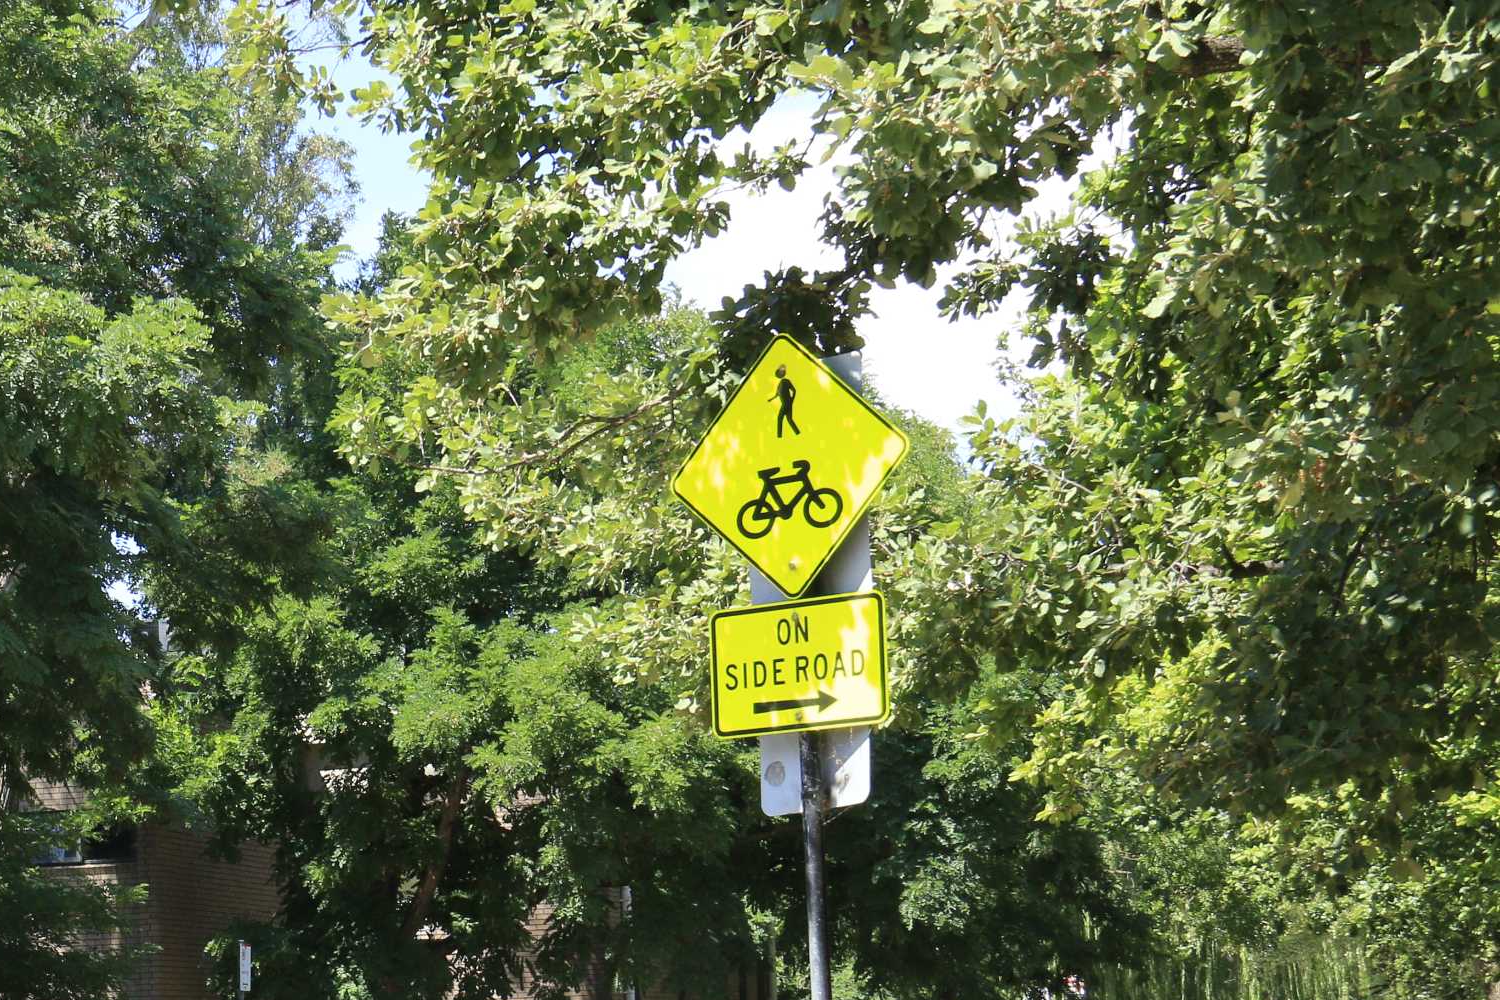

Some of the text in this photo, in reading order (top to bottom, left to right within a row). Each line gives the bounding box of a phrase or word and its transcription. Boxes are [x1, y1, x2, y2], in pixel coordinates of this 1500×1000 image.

[776, 615, 809, 645] ON
[725, 649, 865, 692] SIDE ROAD
